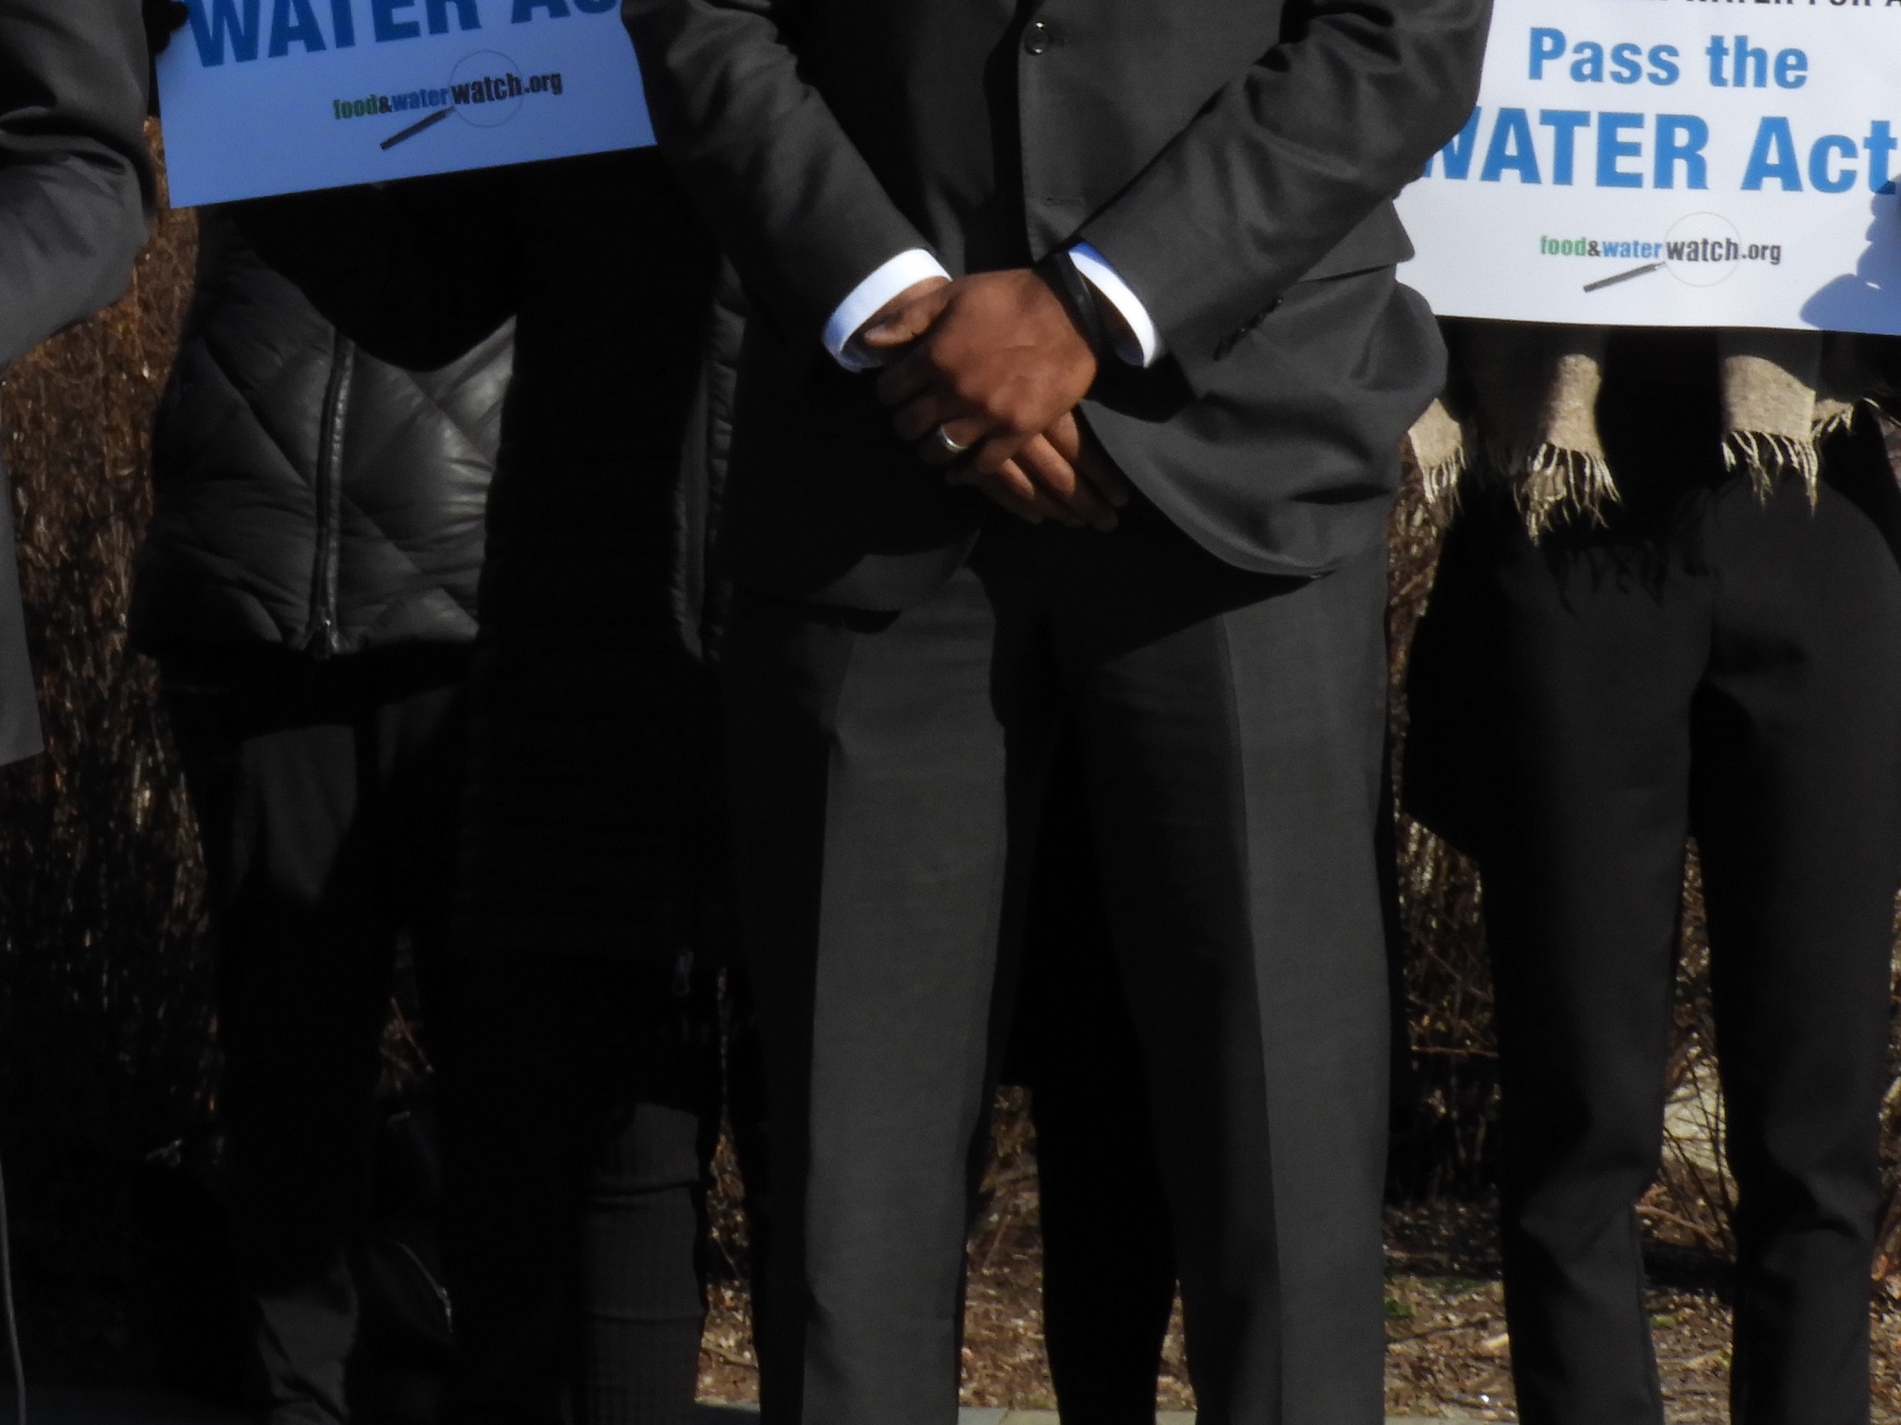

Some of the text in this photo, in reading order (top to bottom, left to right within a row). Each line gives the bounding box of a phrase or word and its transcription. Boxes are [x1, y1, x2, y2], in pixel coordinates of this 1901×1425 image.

[1529, 27, 1809, 90] Pass the
[1741, 116, 1899, 196] Act
